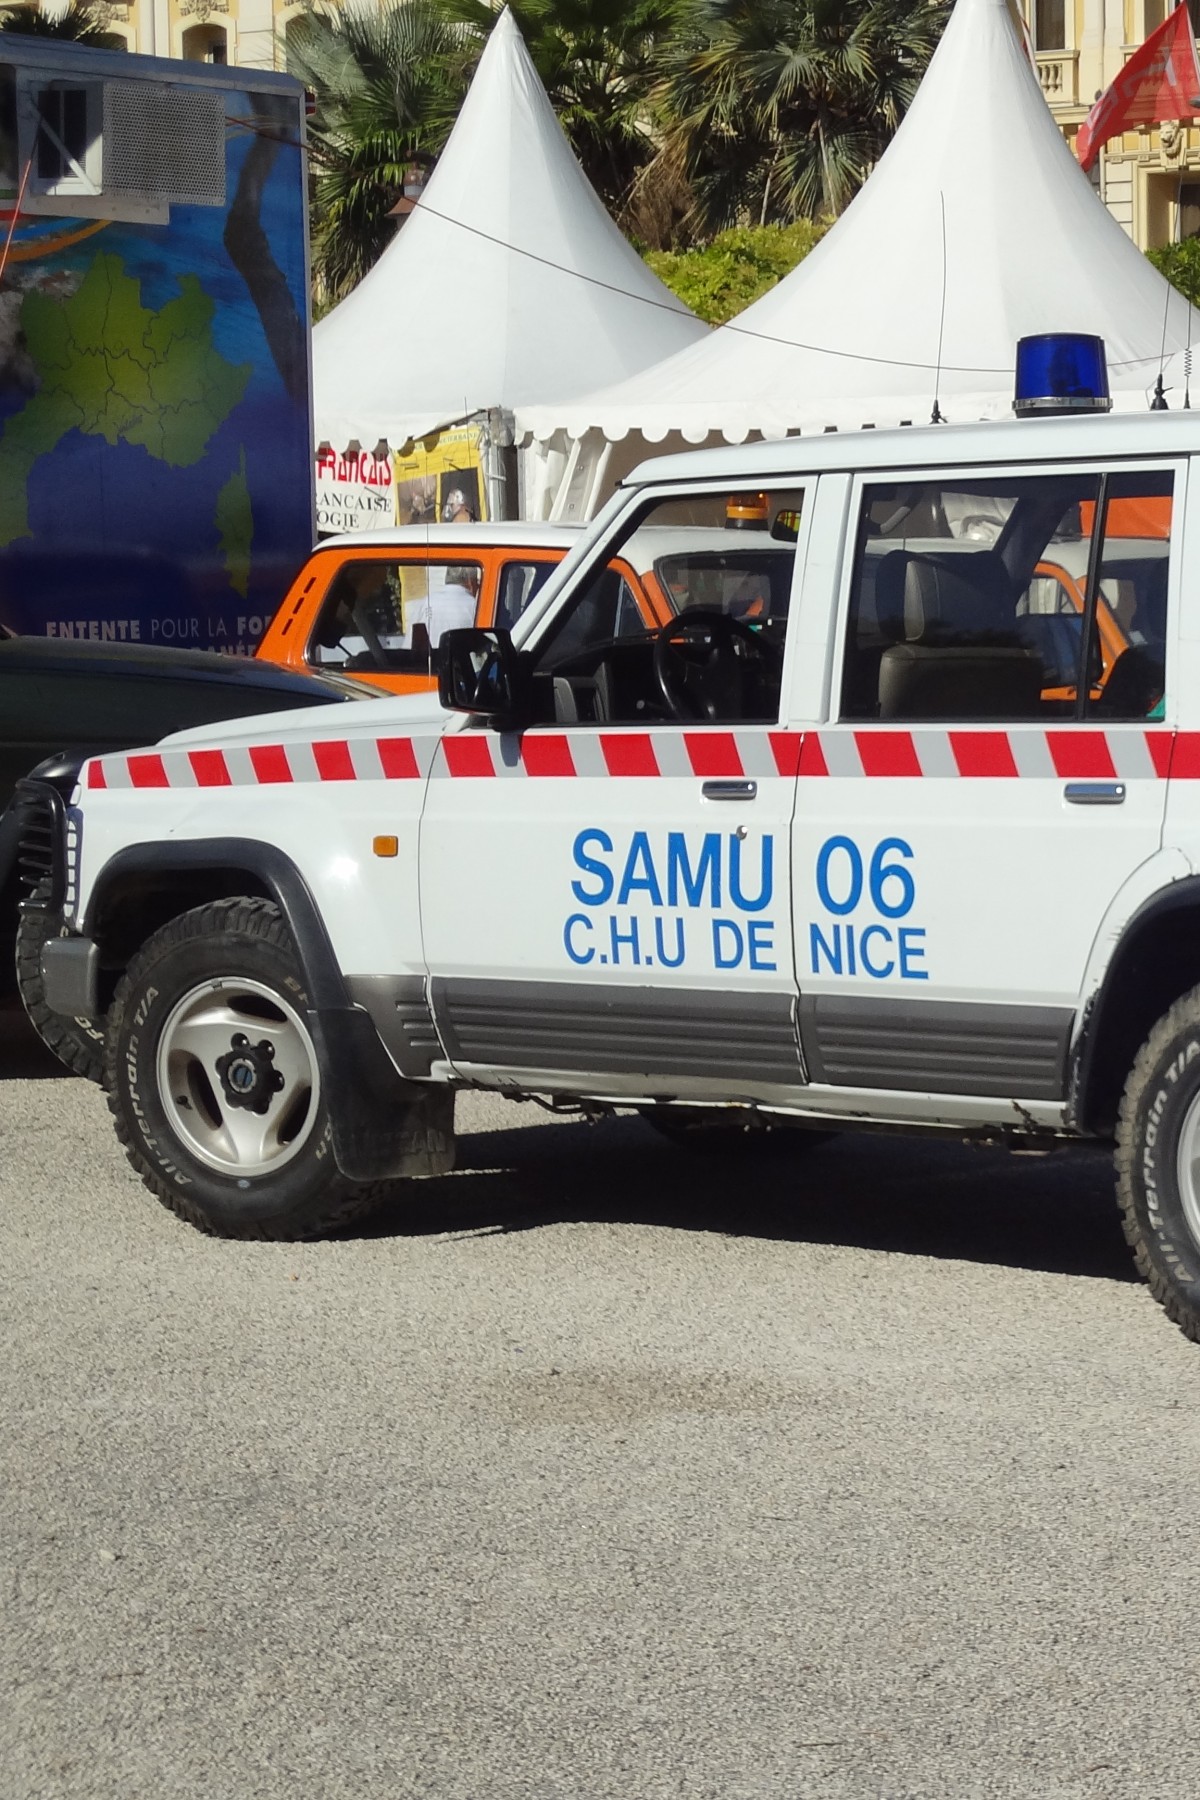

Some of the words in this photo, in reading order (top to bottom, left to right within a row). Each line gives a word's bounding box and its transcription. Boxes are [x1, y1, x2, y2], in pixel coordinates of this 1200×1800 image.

[316, 492, 392, 513] ANCAISE
[316, 510, 359, 529] OGIE
[46, 620, 141, 641] ENTENTE
[151, 618, 200, 638] POUR
[208, 617, 228, 636] LA
[571, 827, 774, 912] SAMU
[815, 834, 915, 919] 06
[563, 913, 686, 968] C.H.U
[711, 918, 777, 972] DE
[809, 922, 929, 980] NICE
